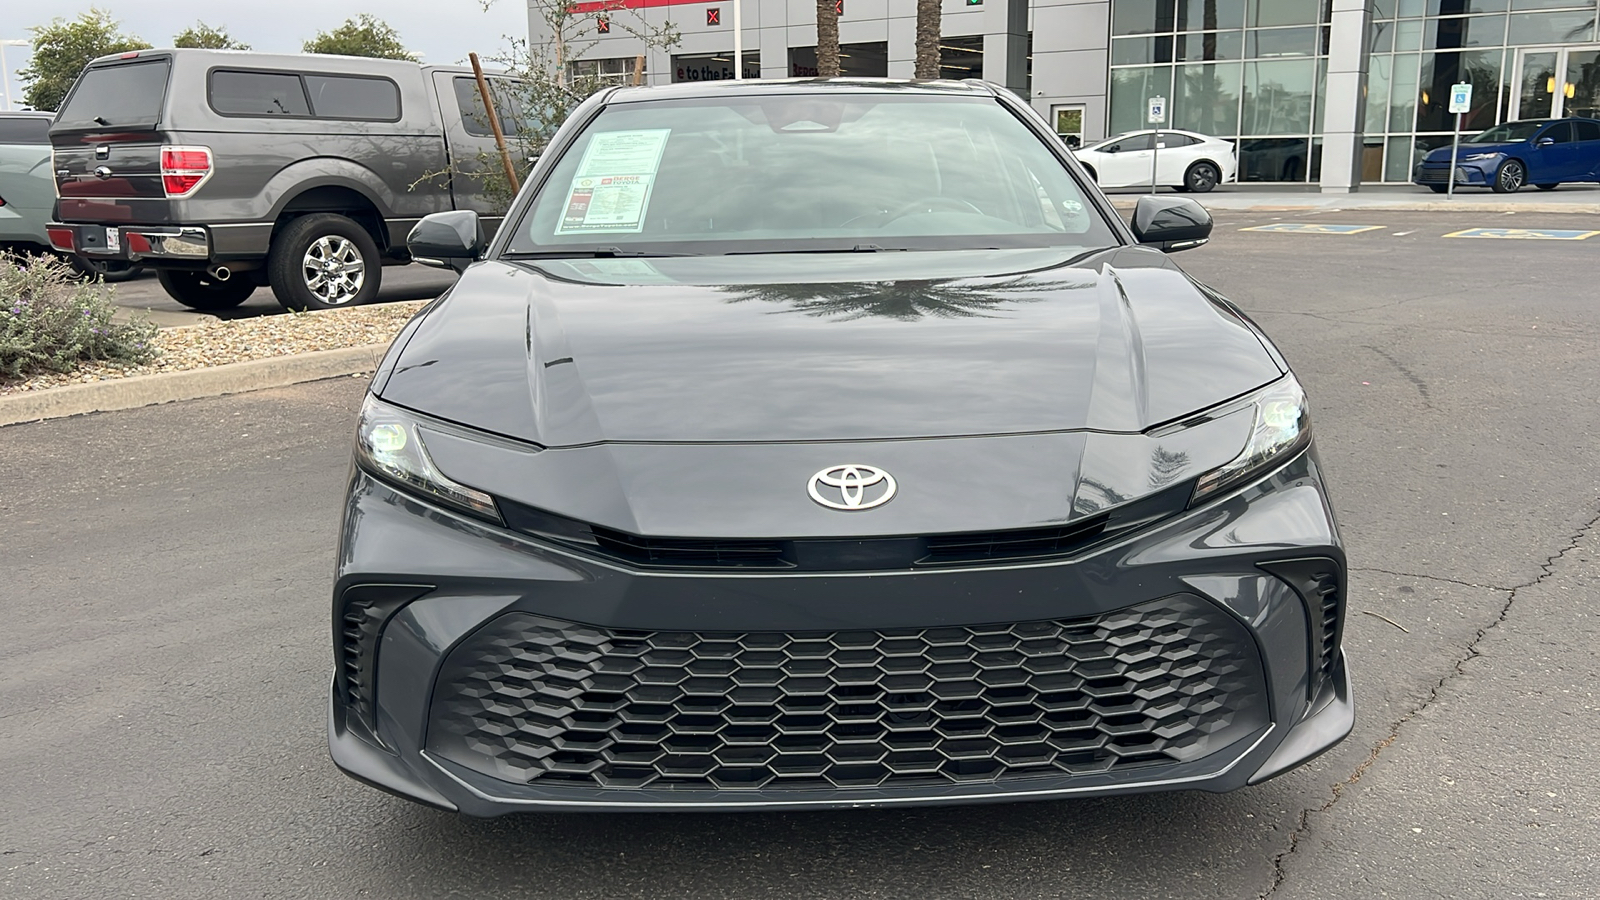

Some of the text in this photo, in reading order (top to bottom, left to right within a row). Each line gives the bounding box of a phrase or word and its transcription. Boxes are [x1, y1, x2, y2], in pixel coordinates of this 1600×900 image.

[686, 66, 699, 81] to
[701, 66, 720, 80] the
[722, 67, 760, 79] Faily!
